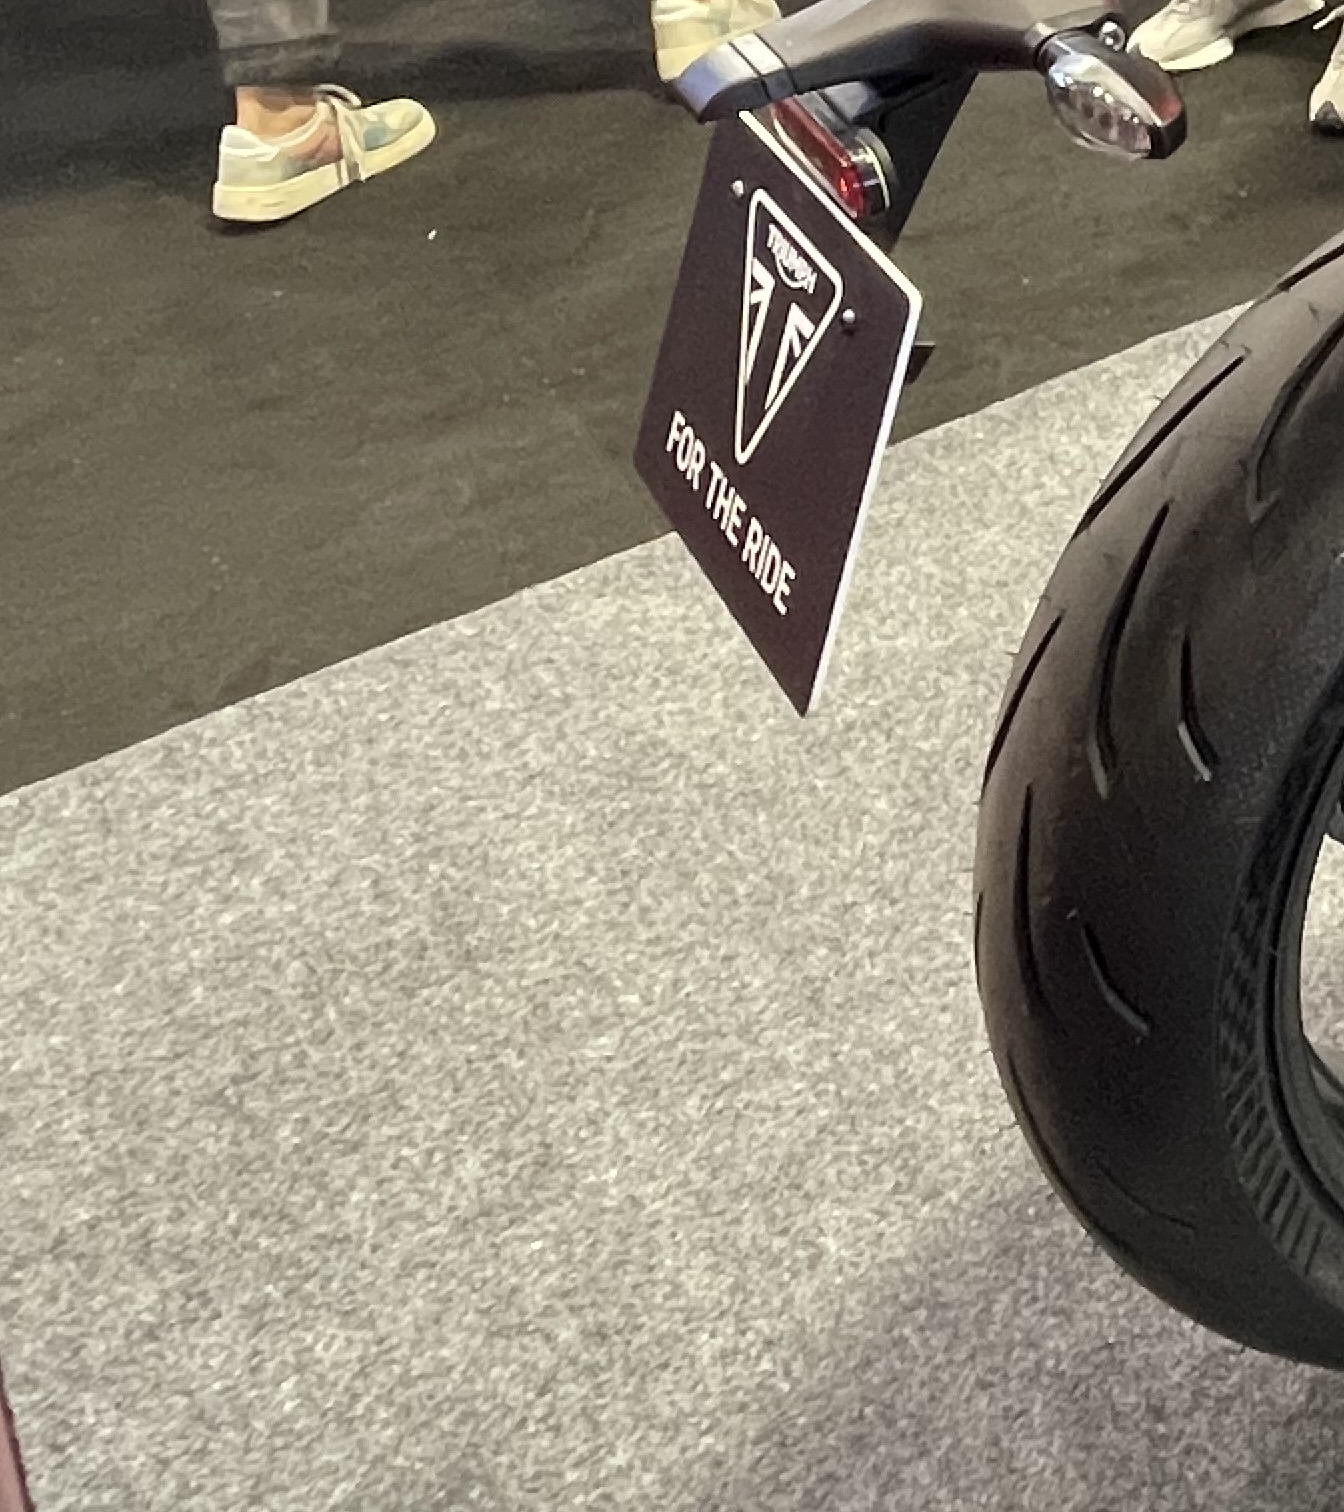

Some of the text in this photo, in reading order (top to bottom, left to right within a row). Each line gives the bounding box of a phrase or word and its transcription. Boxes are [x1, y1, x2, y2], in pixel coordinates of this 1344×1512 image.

[766, 223, 817, 294] TRIUMPH
[665, 410, 796, 616] FOR THE RIDE
